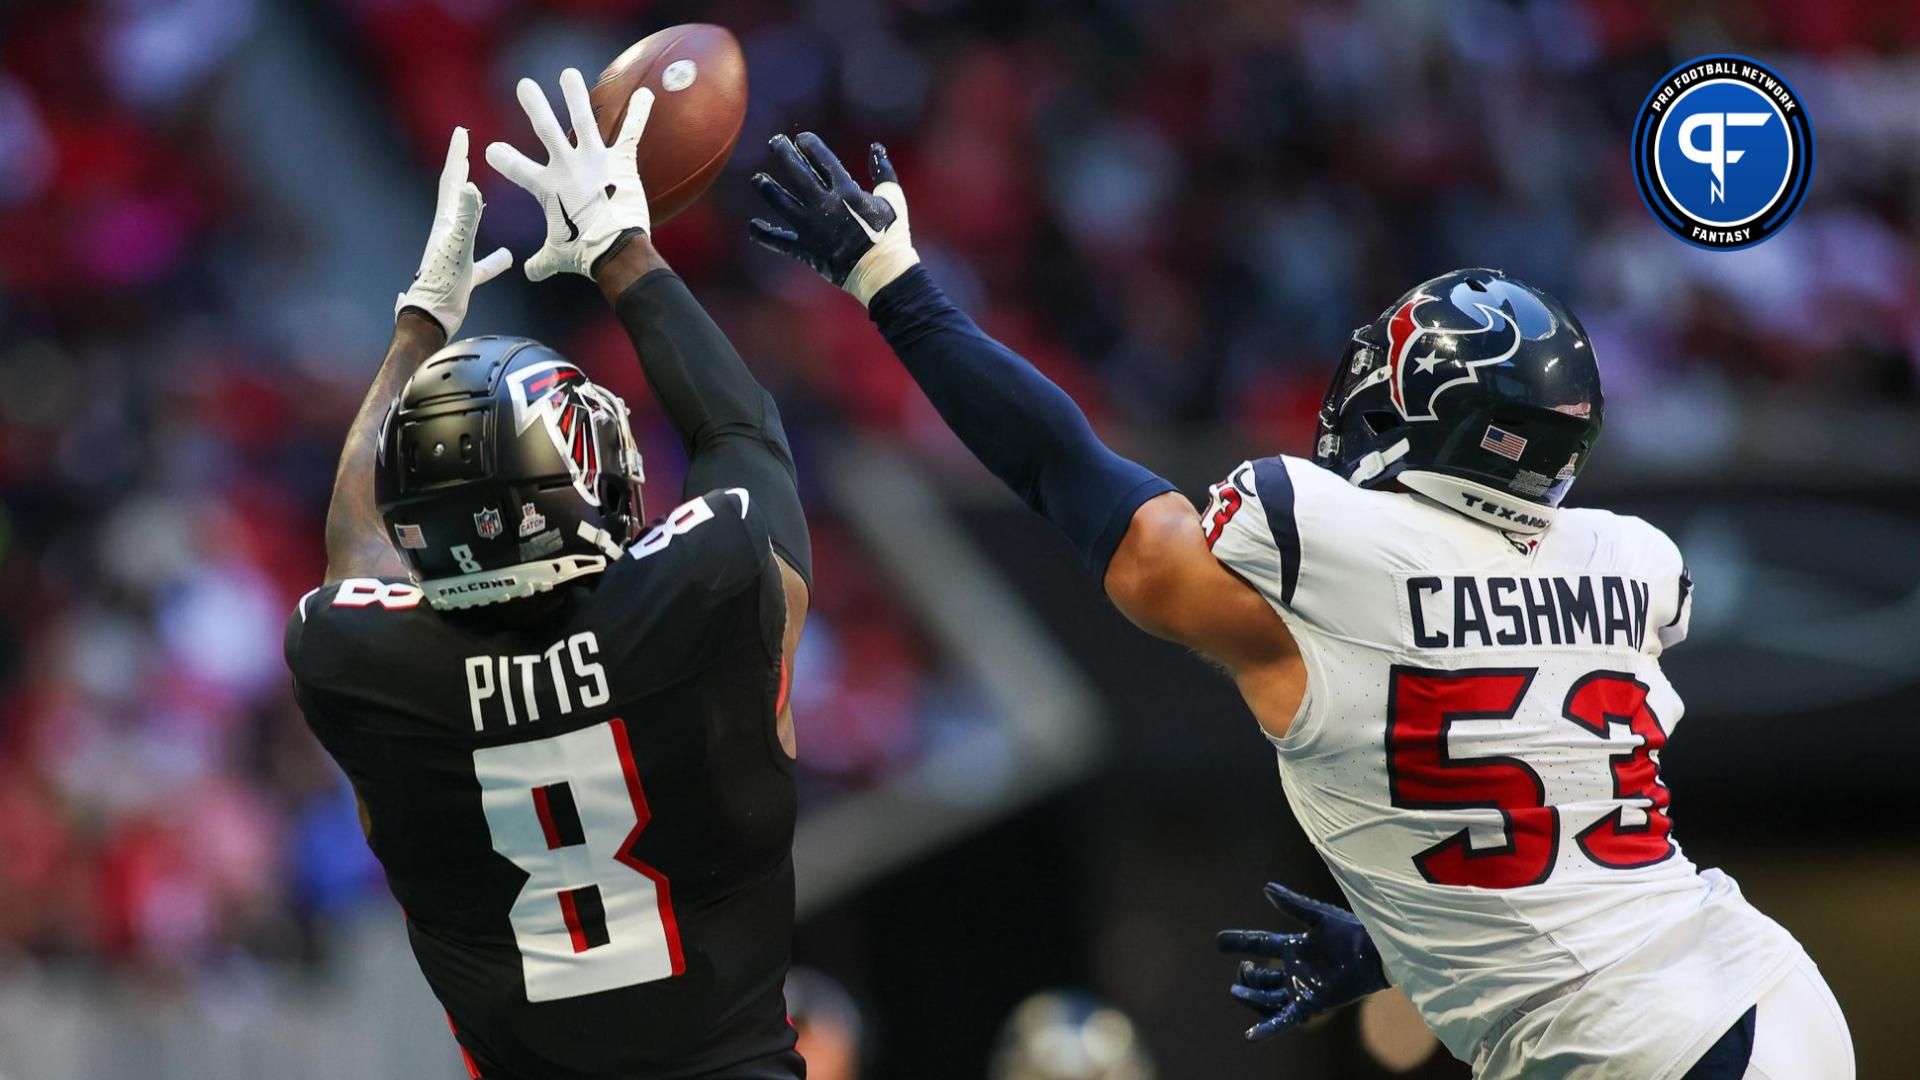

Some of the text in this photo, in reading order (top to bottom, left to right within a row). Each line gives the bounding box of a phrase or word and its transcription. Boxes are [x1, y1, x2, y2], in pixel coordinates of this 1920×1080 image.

[521, 519, 545, 533] CATCH
[1200, 479, 1242, 552] 3
[438, 577, 516, 597] FALCONS
[450, 544, 482, 574] 8
[1406, 576, 1649, 652] CASHMAN
[465, 631, 610, 732] PITTS
[1385, 664, 1676, 889] 53
[472, 717, 687, 1003] 8
